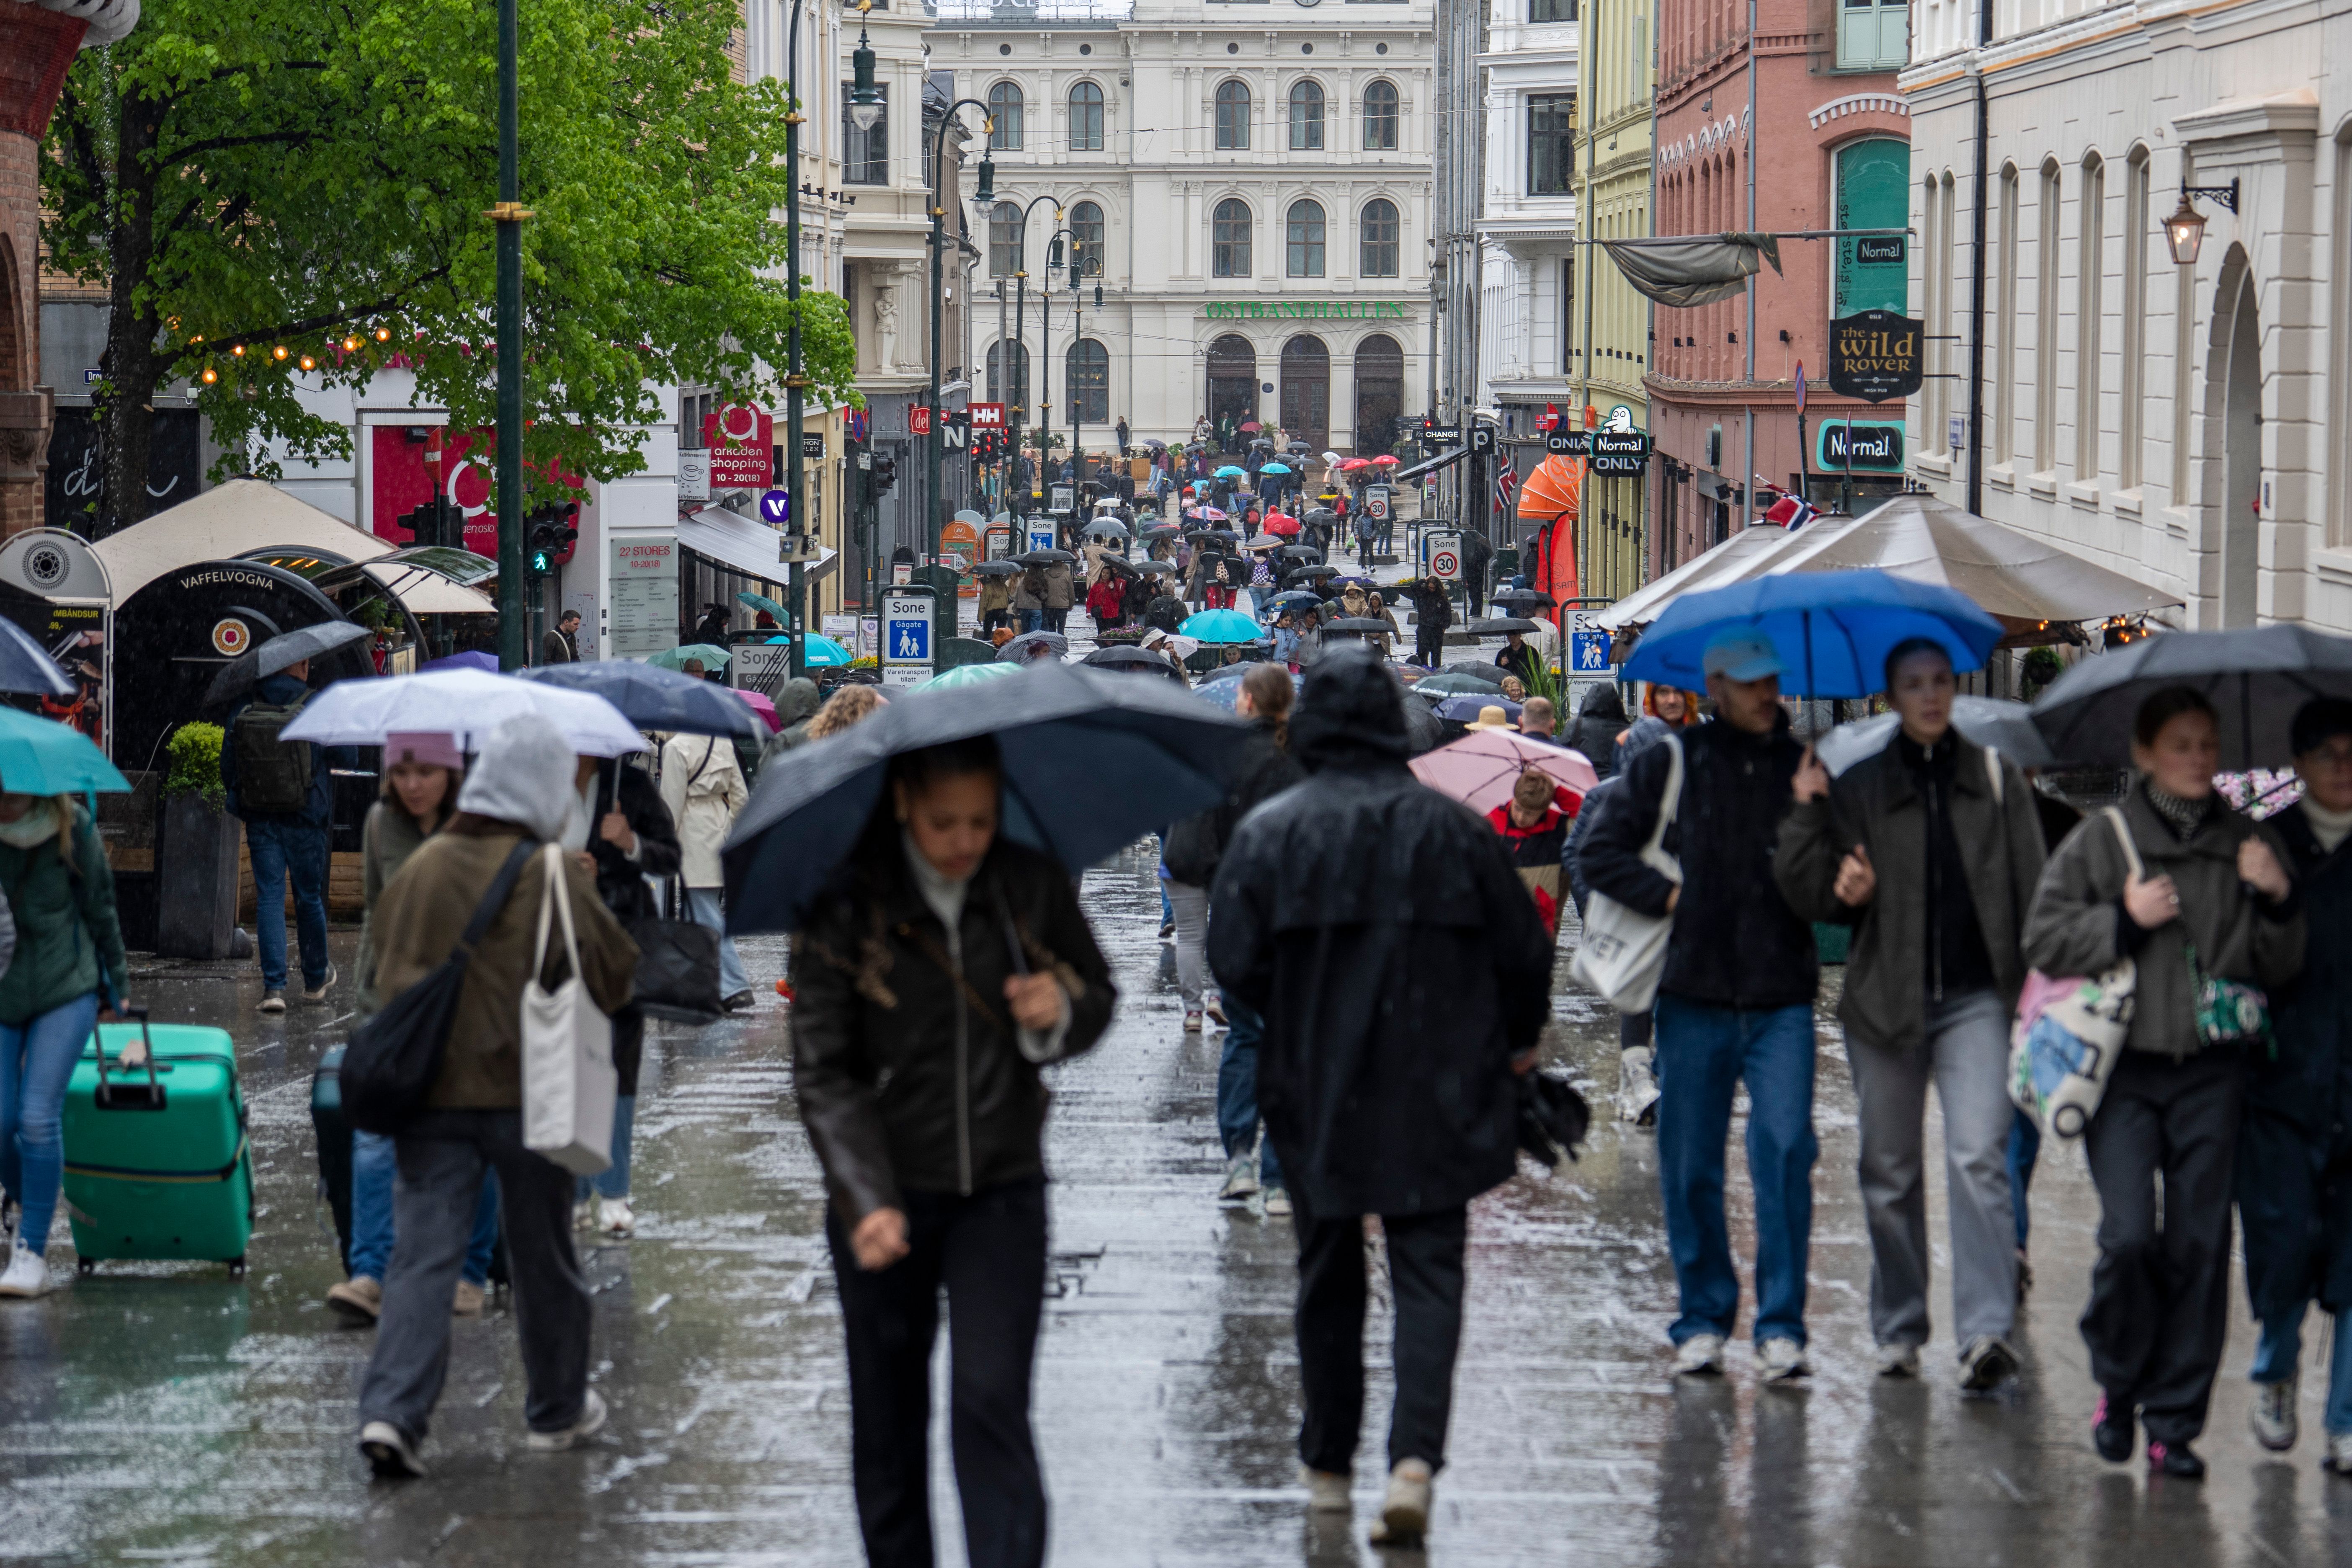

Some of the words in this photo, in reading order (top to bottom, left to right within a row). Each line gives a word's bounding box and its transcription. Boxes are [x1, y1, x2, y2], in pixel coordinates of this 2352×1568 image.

[1862, 242, 1899, 257] Normal
[1207, 302, 1404, 318] ØSTBANEHALLEN
[1599, 437, 1641, 451] Normal
[714, 446, 762, 456] arkaden
[711, 457, 766, 470] shopping
[1596, 458, 1641, 469] ONLY
[620, 547, 631, 556] 22
[633, 546, 670, 556] STORES
[630, 560, 660, 569] 10-20(18)
[1438, 558, 1454, 570] 30
[181, 571, 273, 590] VAFFELVOGNA
[893, 601, 925, 613] Sone
[742, 650, 780, 664] Sone
